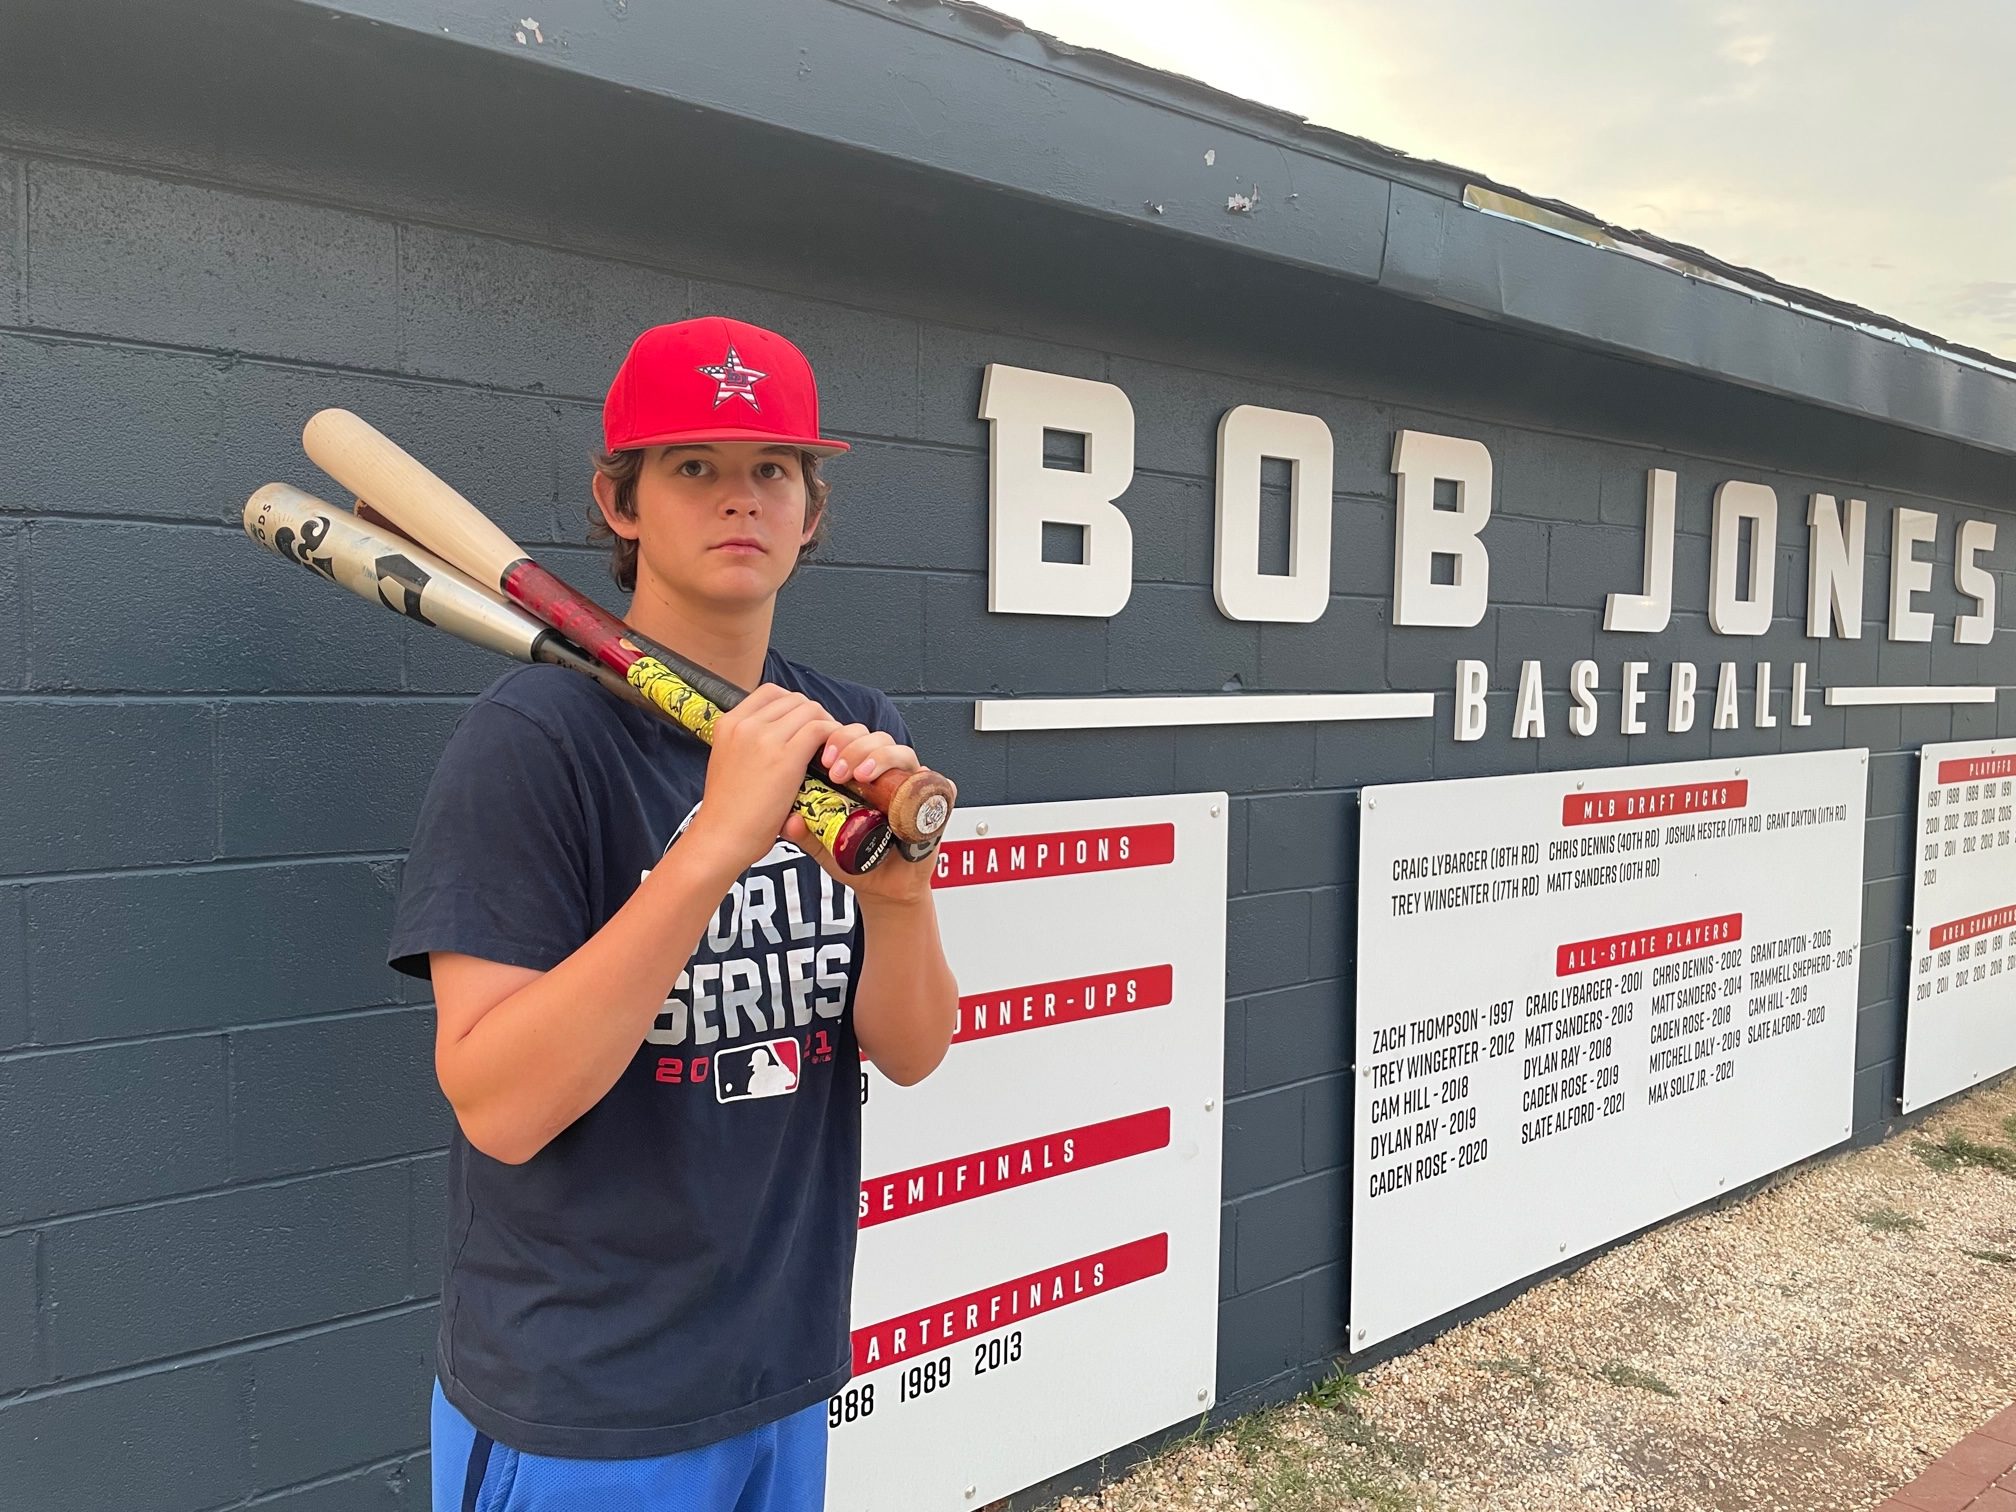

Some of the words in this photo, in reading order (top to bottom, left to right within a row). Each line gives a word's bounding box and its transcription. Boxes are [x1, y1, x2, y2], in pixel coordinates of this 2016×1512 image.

[978, 363, 1493, 628] BOB
[1603, 468, 1998, 645] JONES
[1453, 659, 1812, 742] BASEBALL
[1583, 799, 1615, 819] MLB
[1627, 793, 1675, 815] DRAFT
[1685, 787, 1727, 808] PICKS
[1926, 817, 1939, 834] 2001
[937, 836, 1130, 878] CHAMPIONS
[1393, 856, 1428, 881] CRAIG
[1432, 850, 1488, 876] LYBARGER
[1491, 846, 1519, 870] (18TH
[1521, 842, 1539, 865] RD)
[1549, 839, 1578, 861] CHRIS
[1581, 835, 1615, 857] DENNIS
[1617, 831, 1643, 853] (40TH
[1645, 828, 1660, 848] RD)
[1665, 824, 1695, 845] JOSHUA
[1697, 820, 1726, 840] HESTER
[1728, 817, 1747, 837] (17TH
[1748, 814, 1761, 833] RD)
[1767, 812, 1790, 830] GRANT
[1791, 809, 1816, 827] DAYTON
[1818, 807, 1834, 824] (11TH
[1835, 804, 1846, 821] RD)
[1925, 843, 1938, 861] 2010
[1391, 892, 1421, 917] TREY
[1424, 883, 1489, 912] WINGENTER
[1492, 878, 1519, 903] (17TH
[1522, 874, 1539, 897] RD)
[1547, 871, 1573, 893] MATT
[1574, 865, 1617, 889] SANDERS
[1619, 861, 1643, 883] (10TH
[1645, 857, 1660, 878] RD)
[690, 867, 855, 956] ORLD
[1942, 923, 1965, 942] AREA
[1568, 936, 1656, 969] ALL-STATE
[1667, 921, 1729, 949] PLAYERS
[1653, 962, 1680, 987] CHRIS
[1682, 955, 1714, 980] DENNIS
[1721, 948, 1742, 971] 2002
[1751, 941, 1777, 964] GRANT
[1778, 934, 1806, 957] DAYTON
[1813, 929, 1831, 949] 2006
[1750, 963, 1791, 990] TRAMMELL
[1792, 954, 1831, 979] SHEPHERD
[1836, 949, 1852, 968] 2016
[645, 943, 851, 1046] SERIES
[1526, 990, 1558, 1017] CRAIG
[1561, 978, 1612, 1009] LYBARGER
[1621, 970, 1643, 994] 2001
[1652, 991, 1676, 1016] MATT
[1677, 981, 1716, 1009] SANDERS
[1723, 975, 1742, 997] 2014
[1749, 995, 1766, 1017] CAM
[1768, 991, 1784, 1012] HILL
[1790, 984, 1807, 1006] 2019
[1373, 1024, 1406, 1054] ZACH
[1410, 1008, 1478, 1045] THOMPSON
[1489, 1000, 1514, 1026] 1997
[1525, 1021, 1553, 1049] MATT
[1555, 1009, 1602, 1041] SANDERS
[1611, 1002, 1633, 1026] 2013
[1651, 1018, 1680, 1044] CADEN
[1682, 1011, 1705, 1036] ROSE
[1712, 1005, 1731, 1027] 2018
[1748, 1020, 1771, 1044] SLATE
[1772, 1012, 1801, 1037] ALFORD
[1807, 1005, 1825, 1027] 2020
[1372, 1058, 1404, 1089] TREY
[1407, 1041, 1479, 1079] WINGERTER
[1489, 1031, 1515, 1058] 2012
[1524, 1051, 1558, 1080] DYLAN
[1561, 1045, 1580, 1070] RAY
[1589, 1036, 1612, 1062] 2018
[1649, 1043, 1693, 1074] MITCHELL
[1695, 1036, 1715, 1060] DALY
[1722, 1029, 1741, 1052] 2019
[1372, 1094, 1400, 1124] CAM
[1404, 1086, 1430, 1115] HILL
[1442, 1075, 1468, 1104] 2018
[1523, 1082, 1558, 1112] CADEN
[1561, 1073, 1588, 1100] ROSE
[1596, 1064, 1619, 1090] 2019
[1648, 1081, 1668, 1105] MAX
[1670, 1072, 1695, 1098] SOLIZ
[1696, 1069, 1708, 1089] JR.
[1716, 1060, 1734, 1082] 2021
[1371, 1125, 1412, 1160] DYLAN
[1416, 1117, 1439, 1146] RAY
[1450, 1107, 1476, 1135] 2019
[1522, 1114, 1553, 1144] SLATE
[1555, 1101, 1594, 1133] ALFORD
[1603, 1092, 1625, 1117] 2021
[858, 1139, 1074, 1218] SEMIFINALS
[1370, 1162, 1412, 1198] CADEN
[1416, 1151, 1447, 1183] ROSE
[1458, 1138, 1488, 1168] 2020
[866, 1262, 1104, 1364] ARTERFINALS
[828, 1383, 874, 1428] 988
[900, 1356, 951, 1402] 1989
[974, 1331, 1022, 1375] 2013
